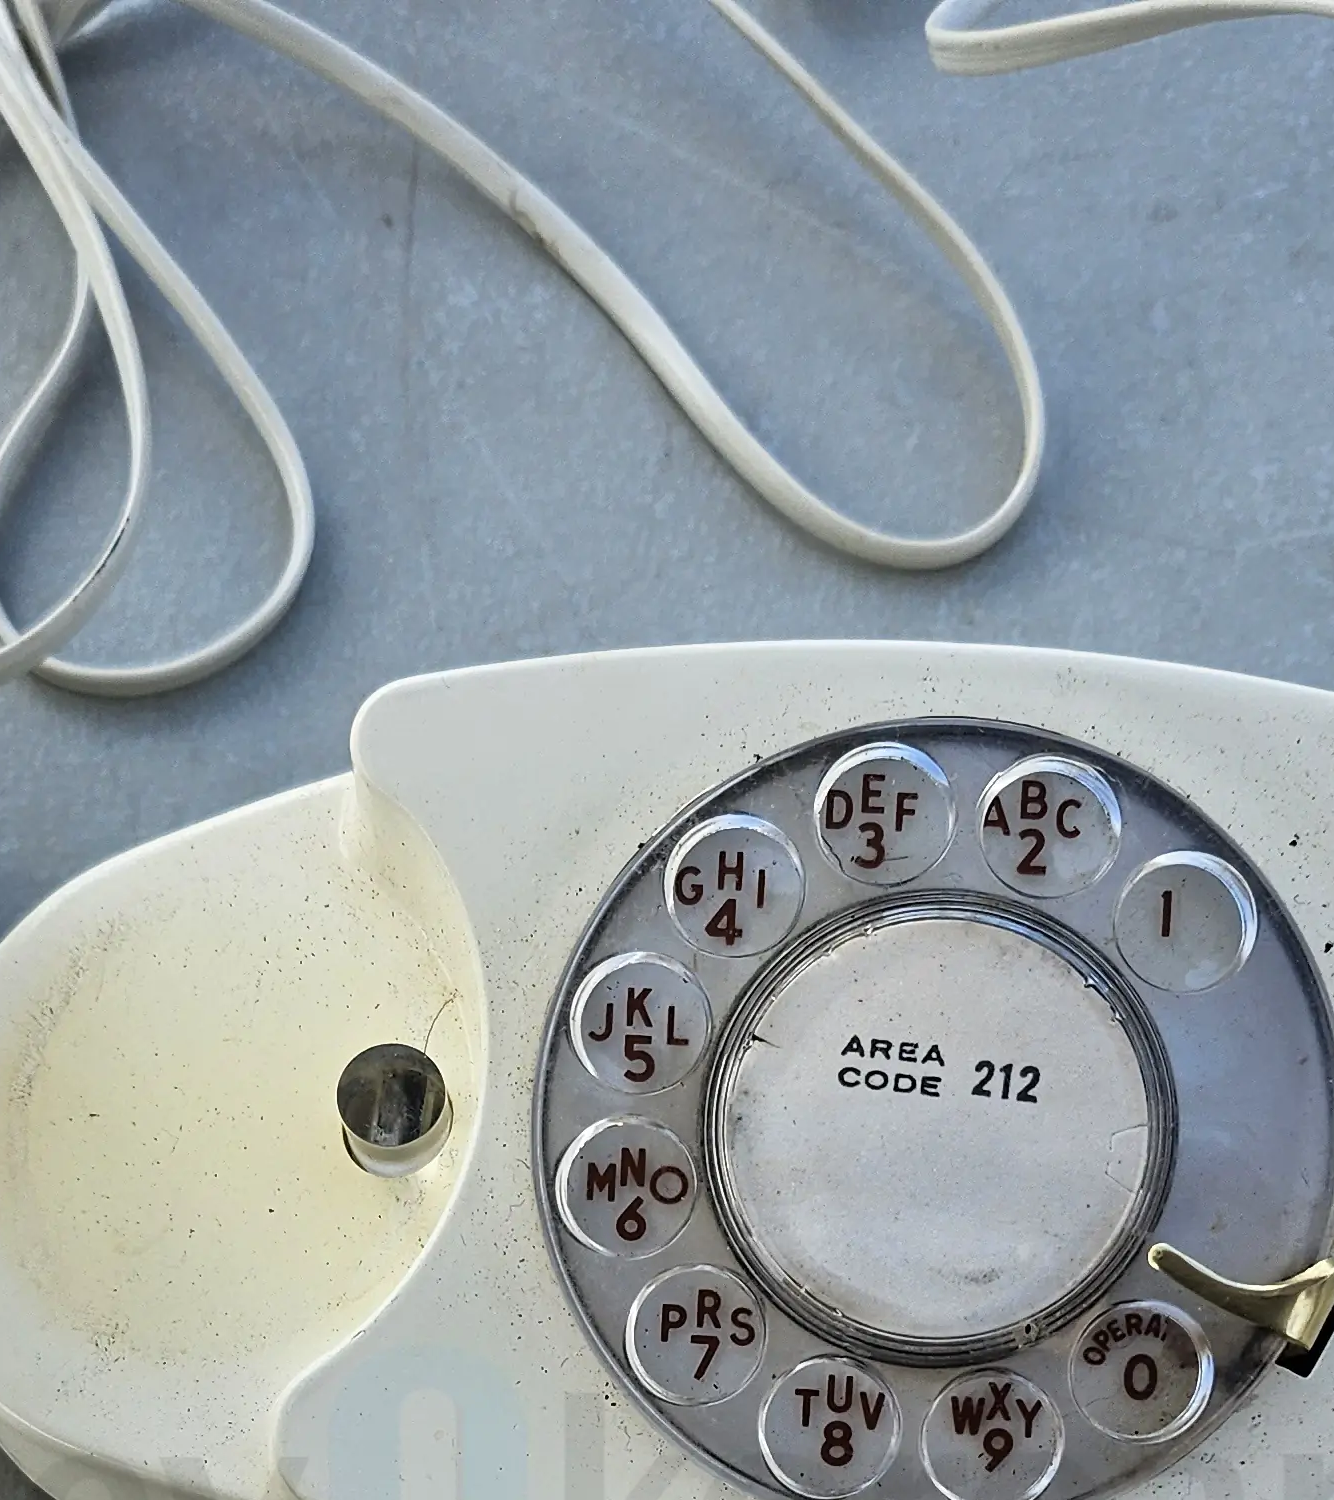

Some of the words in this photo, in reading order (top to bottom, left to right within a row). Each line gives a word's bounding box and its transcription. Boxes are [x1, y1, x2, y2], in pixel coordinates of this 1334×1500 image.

[824, 773, 919, 832] DEF
[982, 779, 1083, 839] ABC
[853, 821, 886, 870] 3
[1016, 828, 1047, 876] 2
[674, 850, 767, 909] GHI
[703, 898, 743, 946] 4
[587, 986, 690, 1046] JKL
[623, 1034, 656, 1083] 5
[840, 1034, 946, 1068] AREA
[837, 1066, 943, 1098] CODE
[970, 1059, 1041, 1104] 212
[586, 1146, 690, 1205] MNO
[615, 1195, 647, 1242] 6
[659, 1288, 757, 1347] PRS
[689, 1334, 721, 1381] 7
[1123, 1353, 1158, 1401] 0
[794, 1373, 886, 1431] TUV
[950, 1381, 1043, 1439] WXY
[819, 1420, 854, 1467] 8
[982, 1427, 1014, 1473] 9
